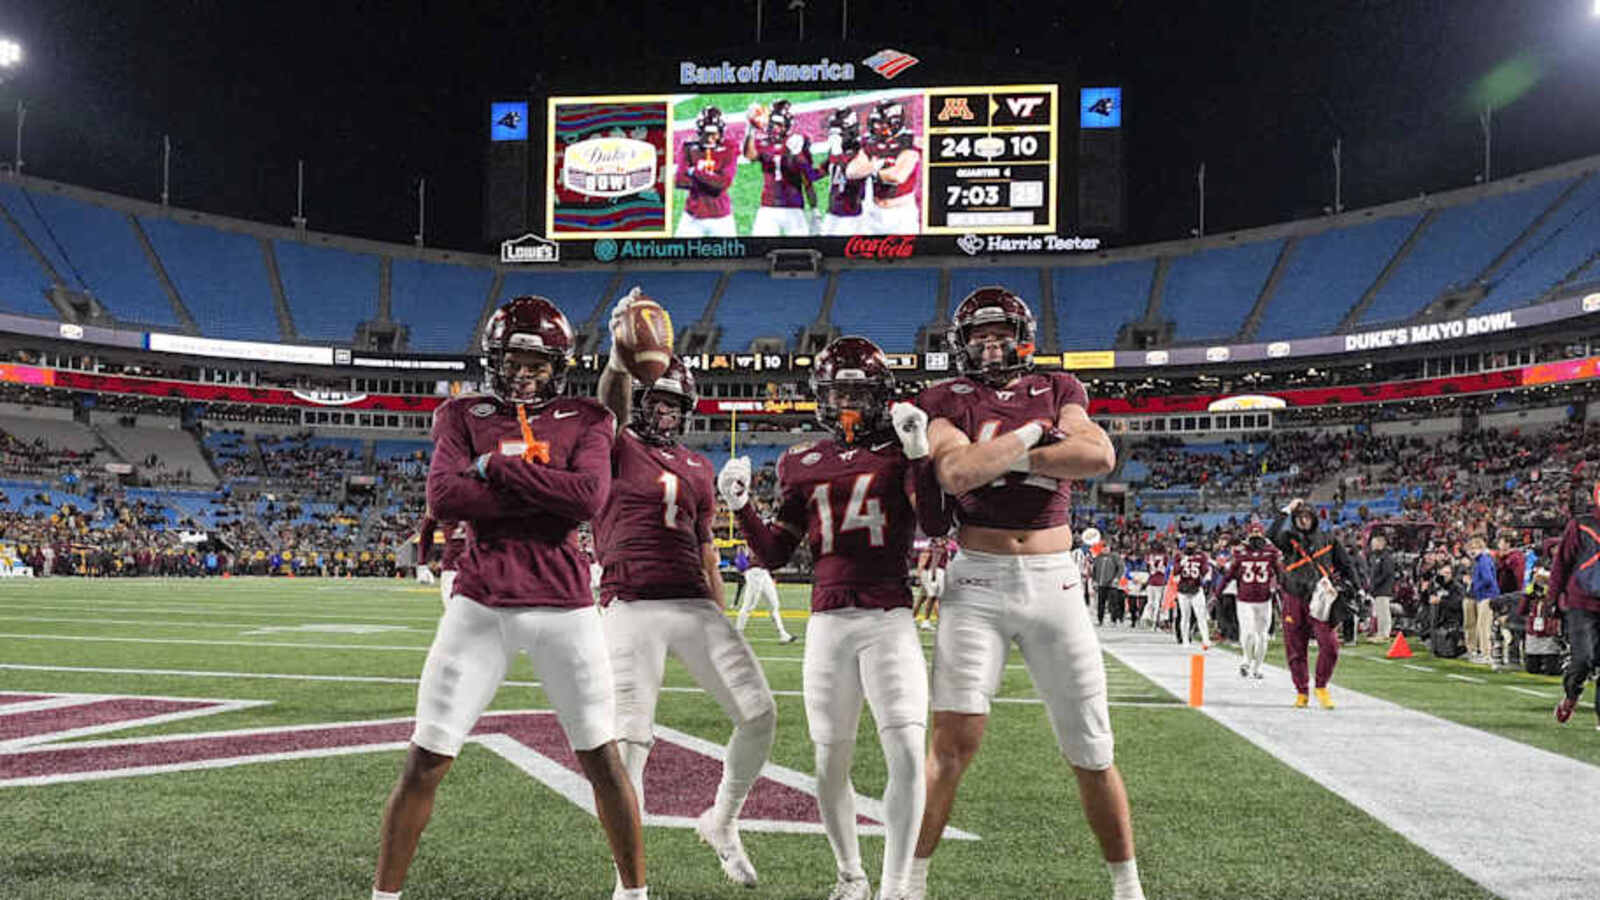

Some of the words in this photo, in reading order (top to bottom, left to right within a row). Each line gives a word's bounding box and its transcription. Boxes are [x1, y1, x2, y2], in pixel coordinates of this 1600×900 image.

[680, 62, 735, 84] Bank
[737, 60, 761, 83] of
[763, 58, 855, 82] America
[1006, 97, 1044, 117] VT
[941, 138, 970, 157] 24
[1010, 136, 1037, 155] 10
[585, 174, 632, 191] BOWL
[947, 186, 999, 206] 7:03
[621, 241, 685, 257] Atrium
[687, 239, 745, 256] Health
[987, 236, 1043, 251] Harris
[1044, 236, 1101, 251] Teeter
[1345, 327, 1408, 351] DUKE'S
[1411, 320, 1464, 343] MAYO
[1466, 311, 1517, 334] BOWL
[658, 471, 679, 528] 1
[810, 473, 887, 554] 14
[1241, 561, 1270, 583] 33
